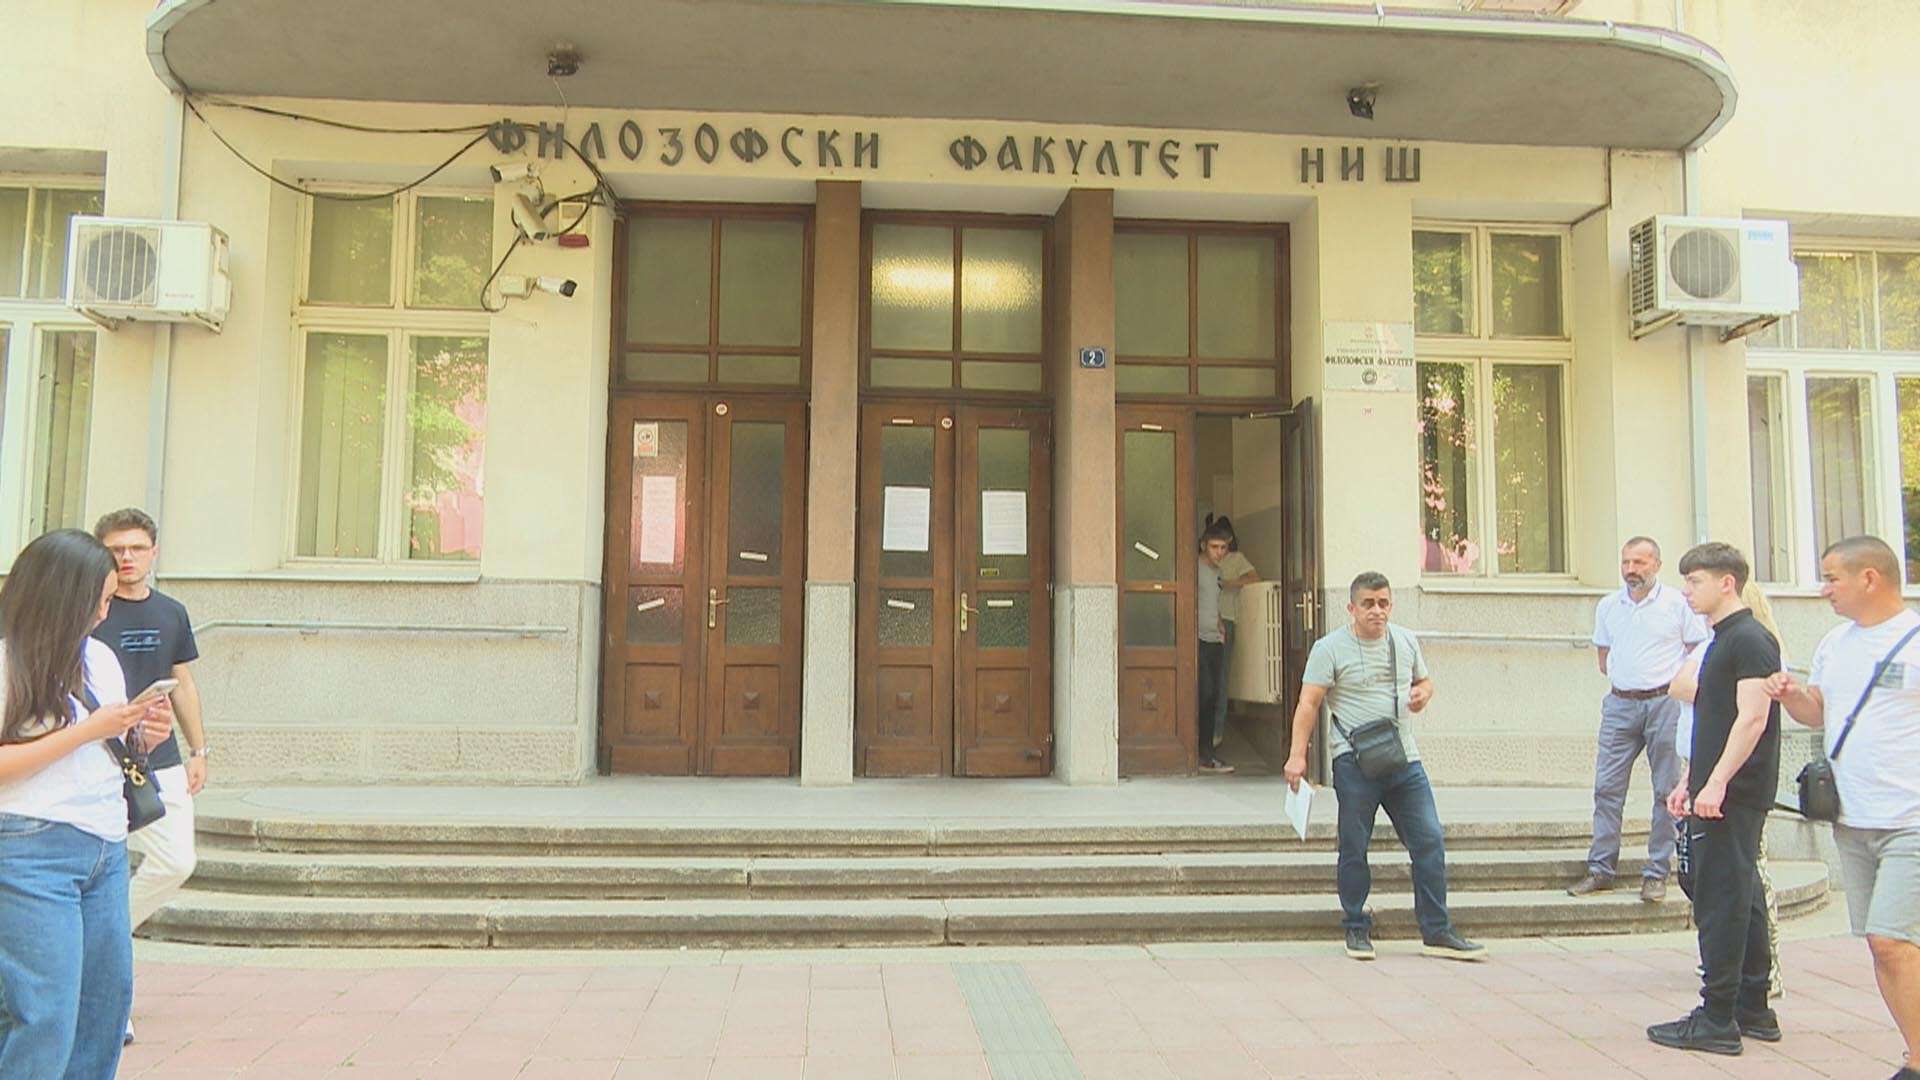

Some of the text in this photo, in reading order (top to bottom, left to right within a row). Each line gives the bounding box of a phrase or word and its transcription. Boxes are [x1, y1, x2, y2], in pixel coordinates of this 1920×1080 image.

[488, 117, 1421, 183] ФИЛОЗОФСКИ ФАКУЛТЕТ НИШ
[1089, 351, 1096, 366] 2
